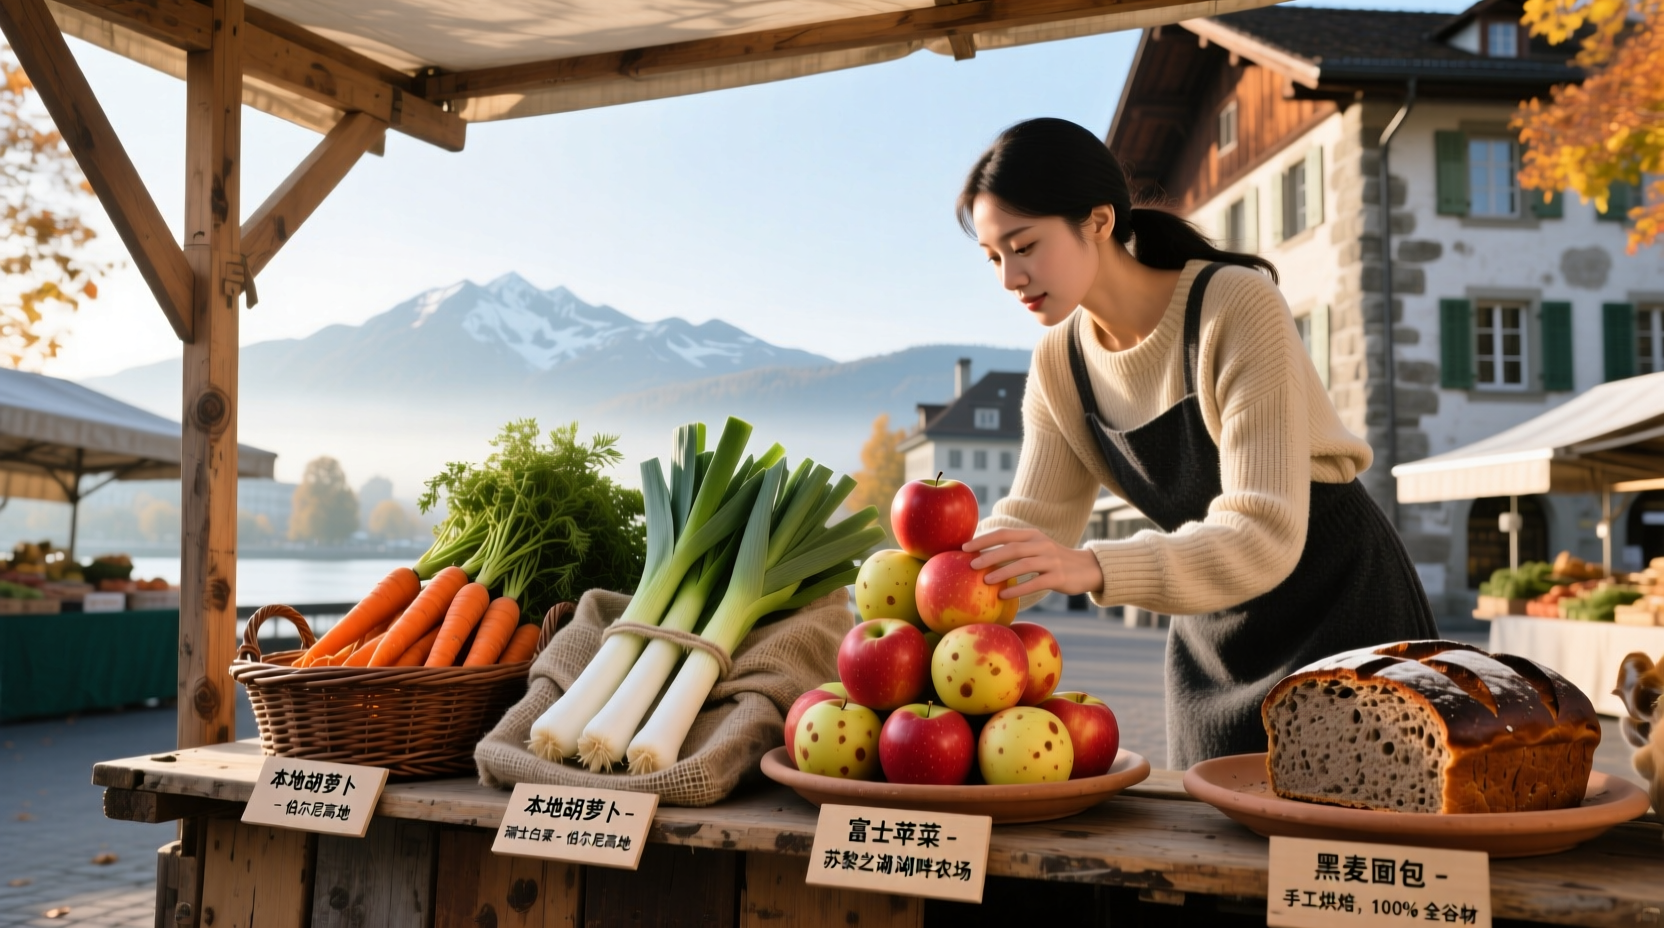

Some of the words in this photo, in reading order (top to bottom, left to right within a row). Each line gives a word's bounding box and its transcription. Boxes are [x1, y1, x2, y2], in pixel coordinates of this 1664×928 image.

[270, 768, 356, 796] 本地胡萝卜
[286, 799, 351, 821] 伯尔尼高地
[524, 795, 620, 823] 本地胡萝卜
[849, 817, 942, 848] 富士苹菜
[1314, 853, 1426, 889] 黑麦面包
[1372, 899, 1419, 918] 100%
